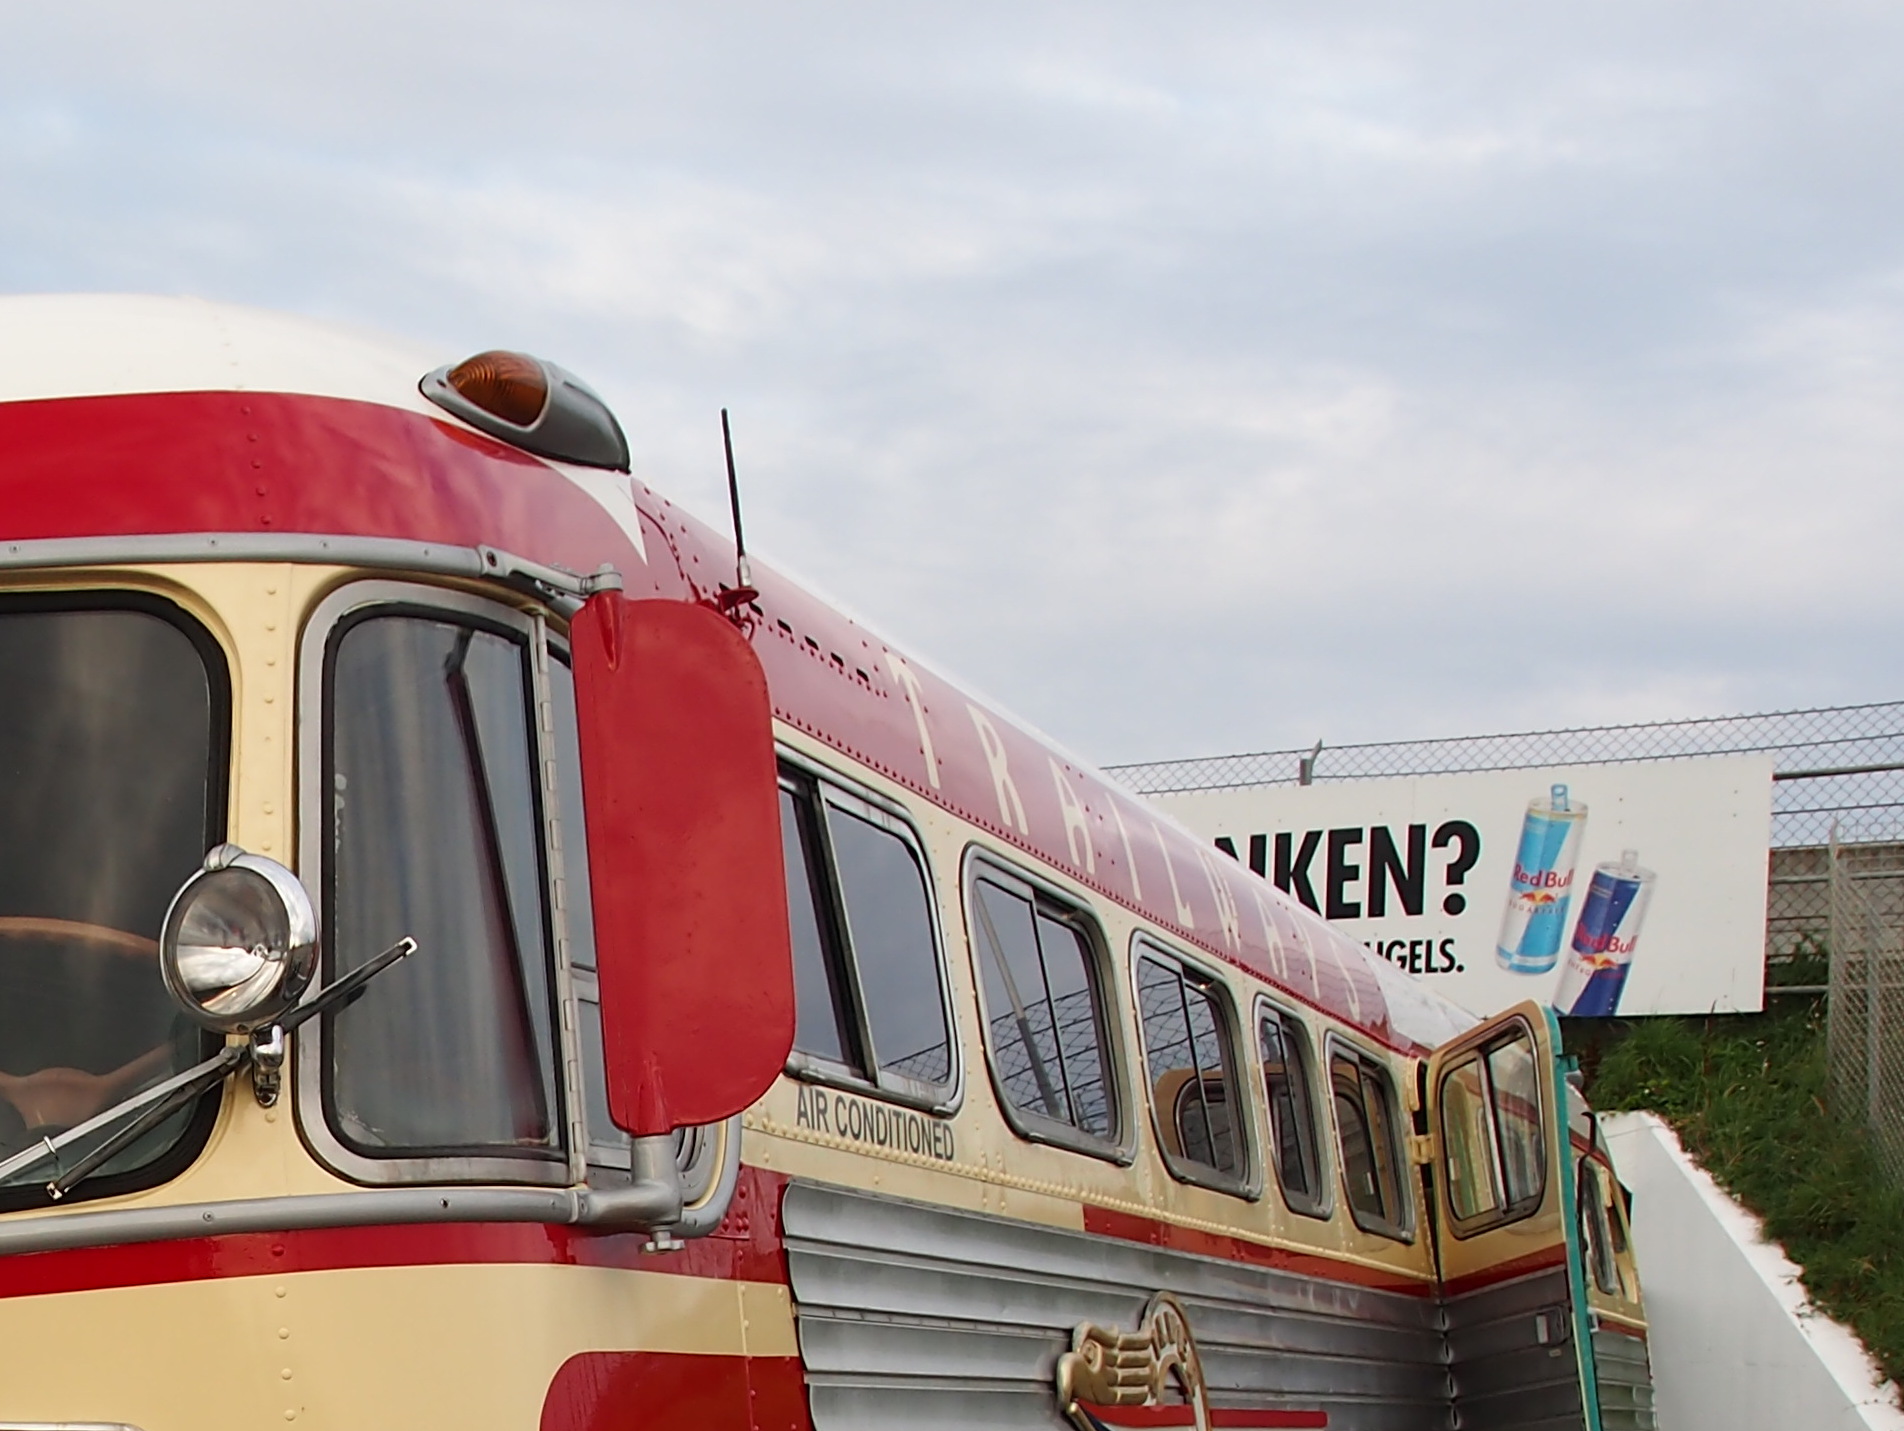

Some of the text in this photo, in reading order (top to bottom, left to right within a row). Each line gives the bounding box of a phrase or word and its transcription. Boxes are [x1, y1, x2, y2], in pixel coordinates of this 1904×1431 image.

[884, 650, 1362, 1020] TRAILWAYS
[1513, 863, 1542, 887] Red
[796, 1084, 955, 1162] AIR CONDITIONED
